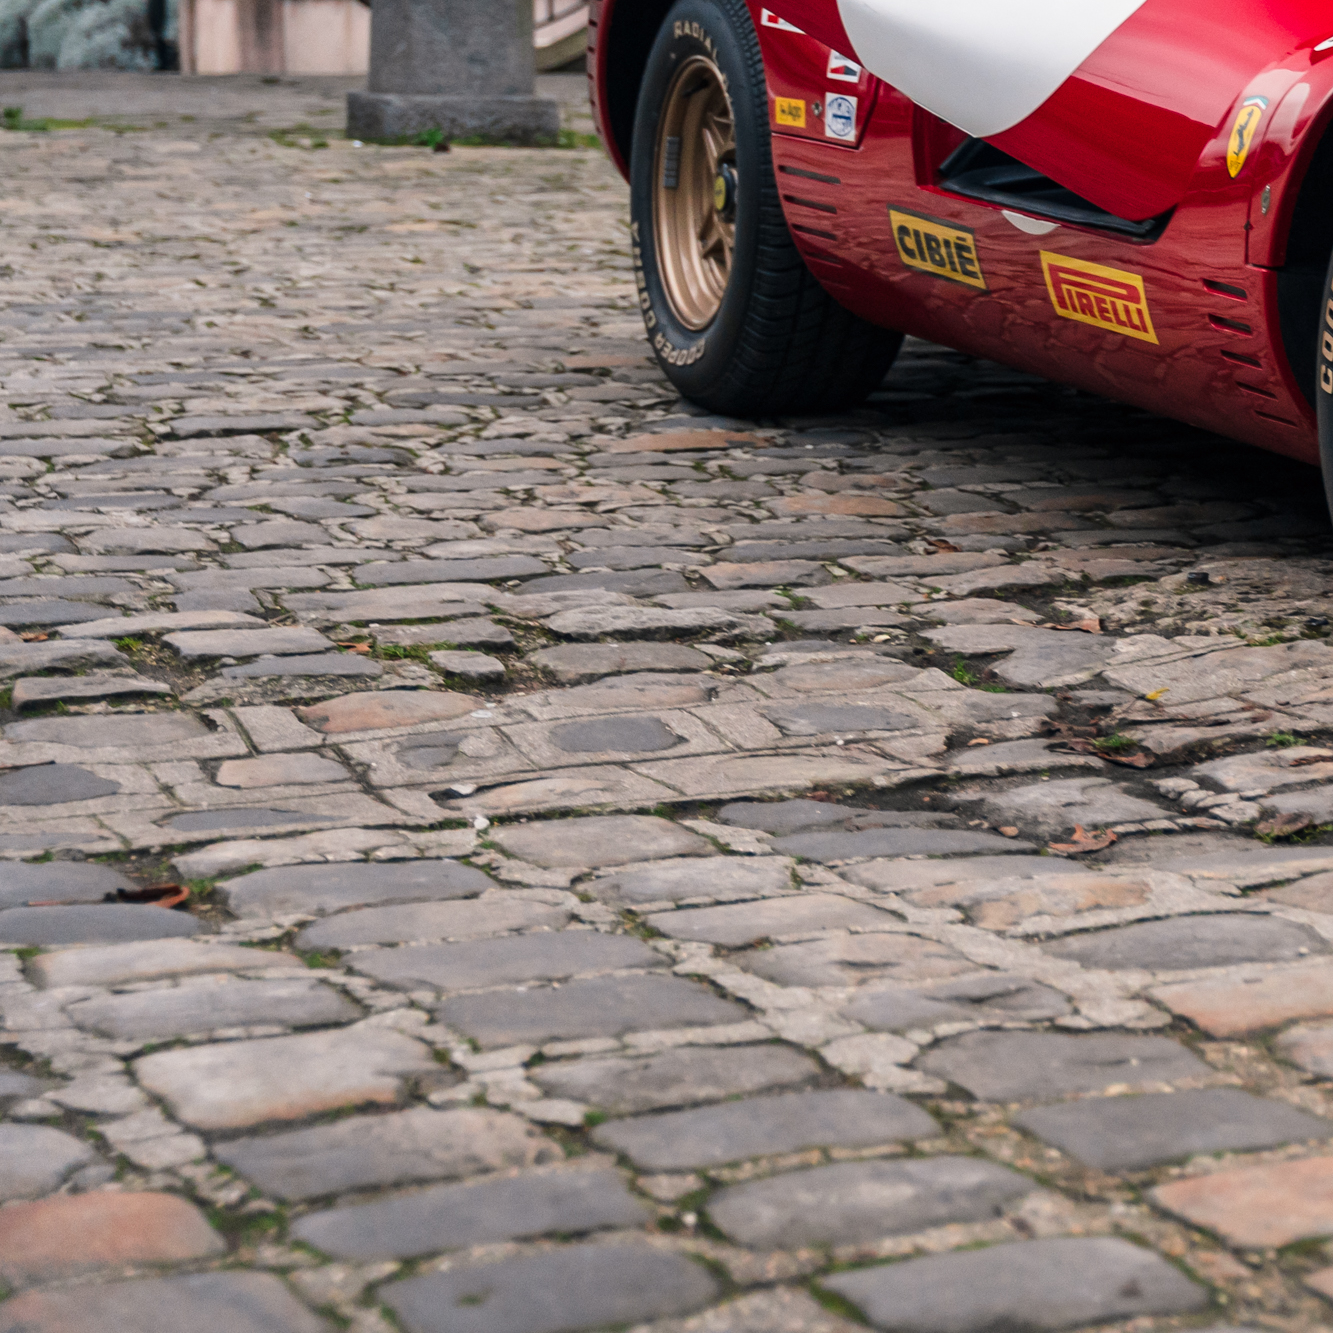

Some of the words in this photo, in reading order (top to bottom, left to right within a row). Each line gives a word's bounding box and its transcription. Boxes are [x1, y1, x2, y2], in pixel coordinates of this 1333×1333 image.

[631, 221, 657, 329] COBRA
[1047, 261, 1150, 335] PIRELLI
[654, 332, 706, 366] COOPER
